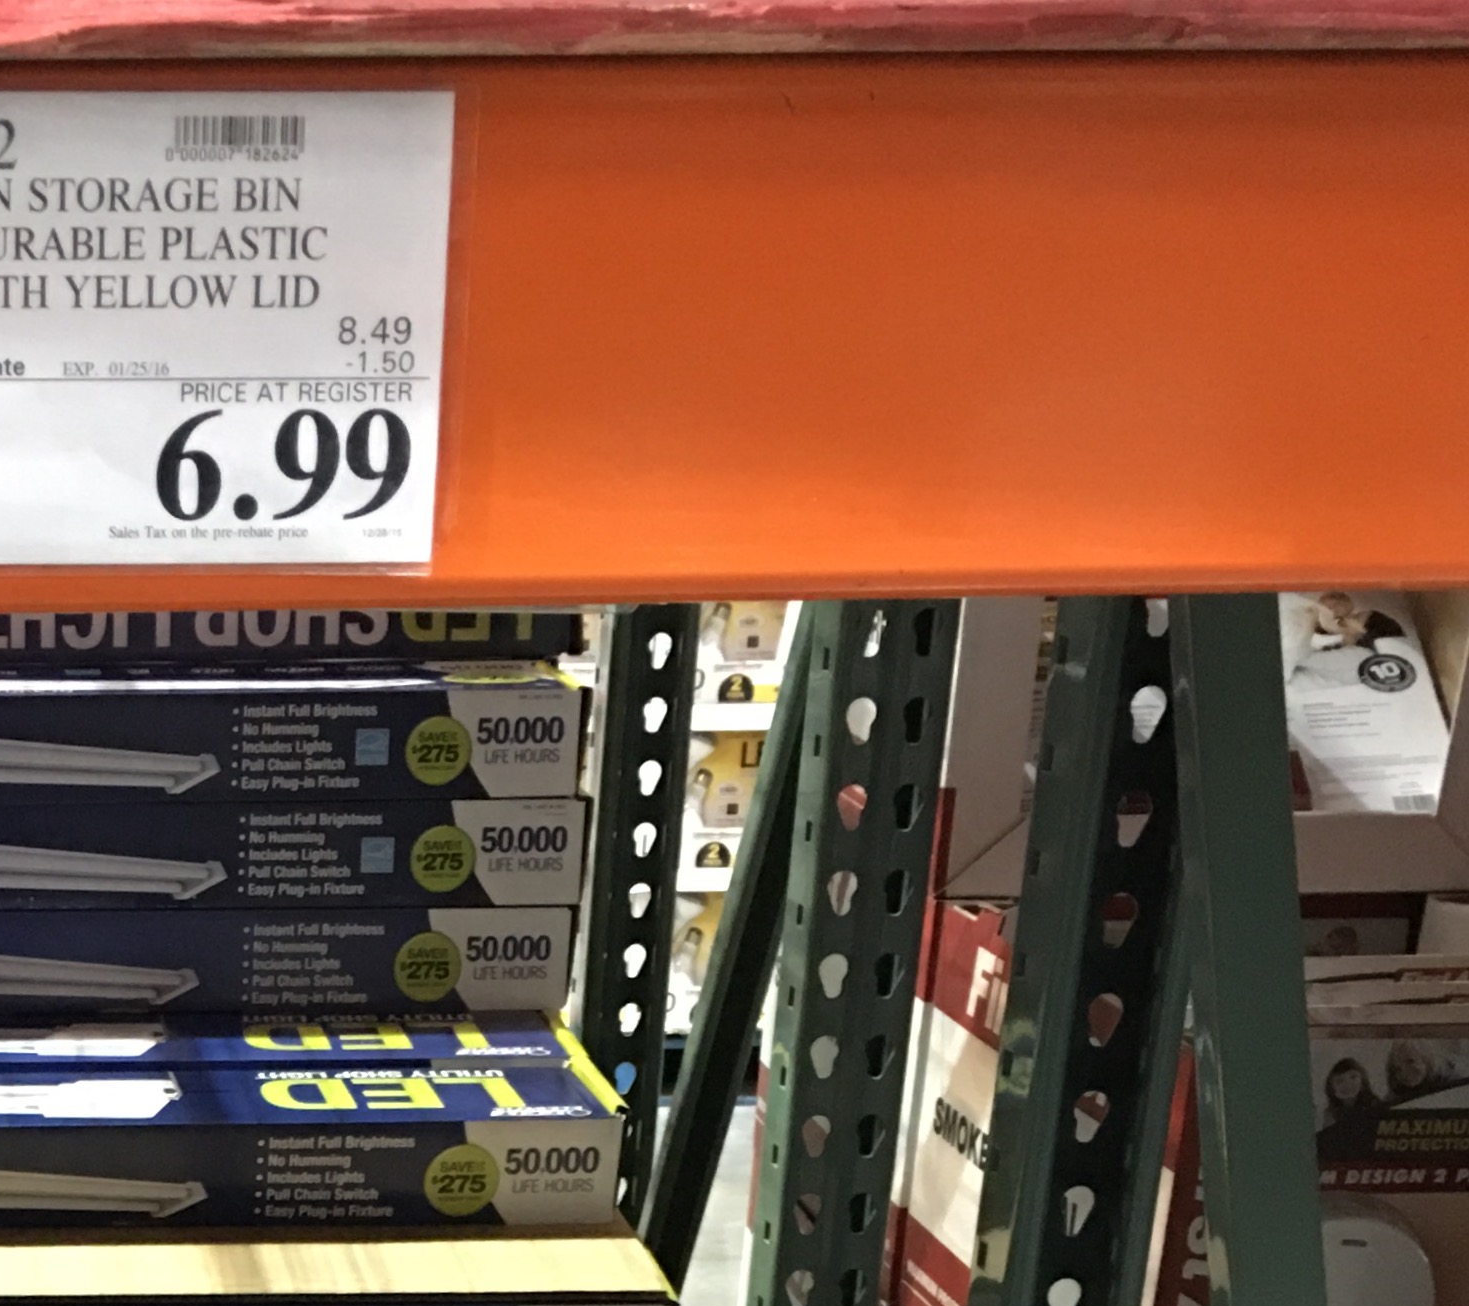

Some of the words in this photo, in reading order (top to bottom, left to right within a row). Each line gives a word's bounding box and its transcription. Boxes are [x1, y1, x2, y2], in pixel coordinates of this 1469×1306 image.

[28, 178, 220, 213] STORAGE
[232, 177, 302, 212] BIN
[160, 225, 329, 261] PLASTIC
[65, 274, 238, 309] YELLOW
[252, 274, 322, 308] LID
[337, 316, 413, 347] 8.49
[63, 361, 97, 377] EXP.
[107, 360, 170, 377] 01/25/16
[346, 352, 415, 374] -1.50
[180, 382, 247, 403] PRICE
[257, 382, 290, 403] AT
[299, 381, 413, 403] REGISTER
[155, 408, 412, 522] 6.99
[109, 525, 140, 539] Sales
[144, 525, 168, 539] Tax
[172, 528, 187, 539] on
[190, 526, 208, 539] the
[212, 525, 273, 542] pre-rebate
[276, 525, 309, 542] price
[244, 705, 286, 718] Instant
[289, 704, 311, 717] Full
[314, 704, 378, 719] Brightness
[243, 723, 260, 735] No
[262, 723, 320, 738] Humming
[243, 741, 292, 753] Includes
[295, 741, 333, 756] Lights
[485, 748, 509, 764] LIFE
[514, 748, 560, 764] HOURS
[242, 758, 264, 771] Pull
[267, 758, 302, 771] Chain
[305, 758, 345, 771] Switch
[242, 777, 269, 791] Easy
[272, 776, 315, 791] Plug-in
[318, 775, 360, 788] Fixture
[488, 858, 511, 872] LIFE
[517, 857, 563, 872] HOURS
[474, 966, 497, 980] LIFE
[502, 966, 547, 980] HOURS
[255, 1071, 327, 1080] LIGHT
[334, 1070, 406, 1079] SHOP
[412, 1069, 504, 1078] UTILITY
[260, 1078, 527, 1110] LED
[1377, 1119, 1469, 1135] MAXIMU
[1345, 1169, 1426, 1184] DESIGN
[1434, 1169, 1447, 1183] 2
[512, 1179, 538, 1194] LIFE
[544, 1178, 594, 1194] HOURS
